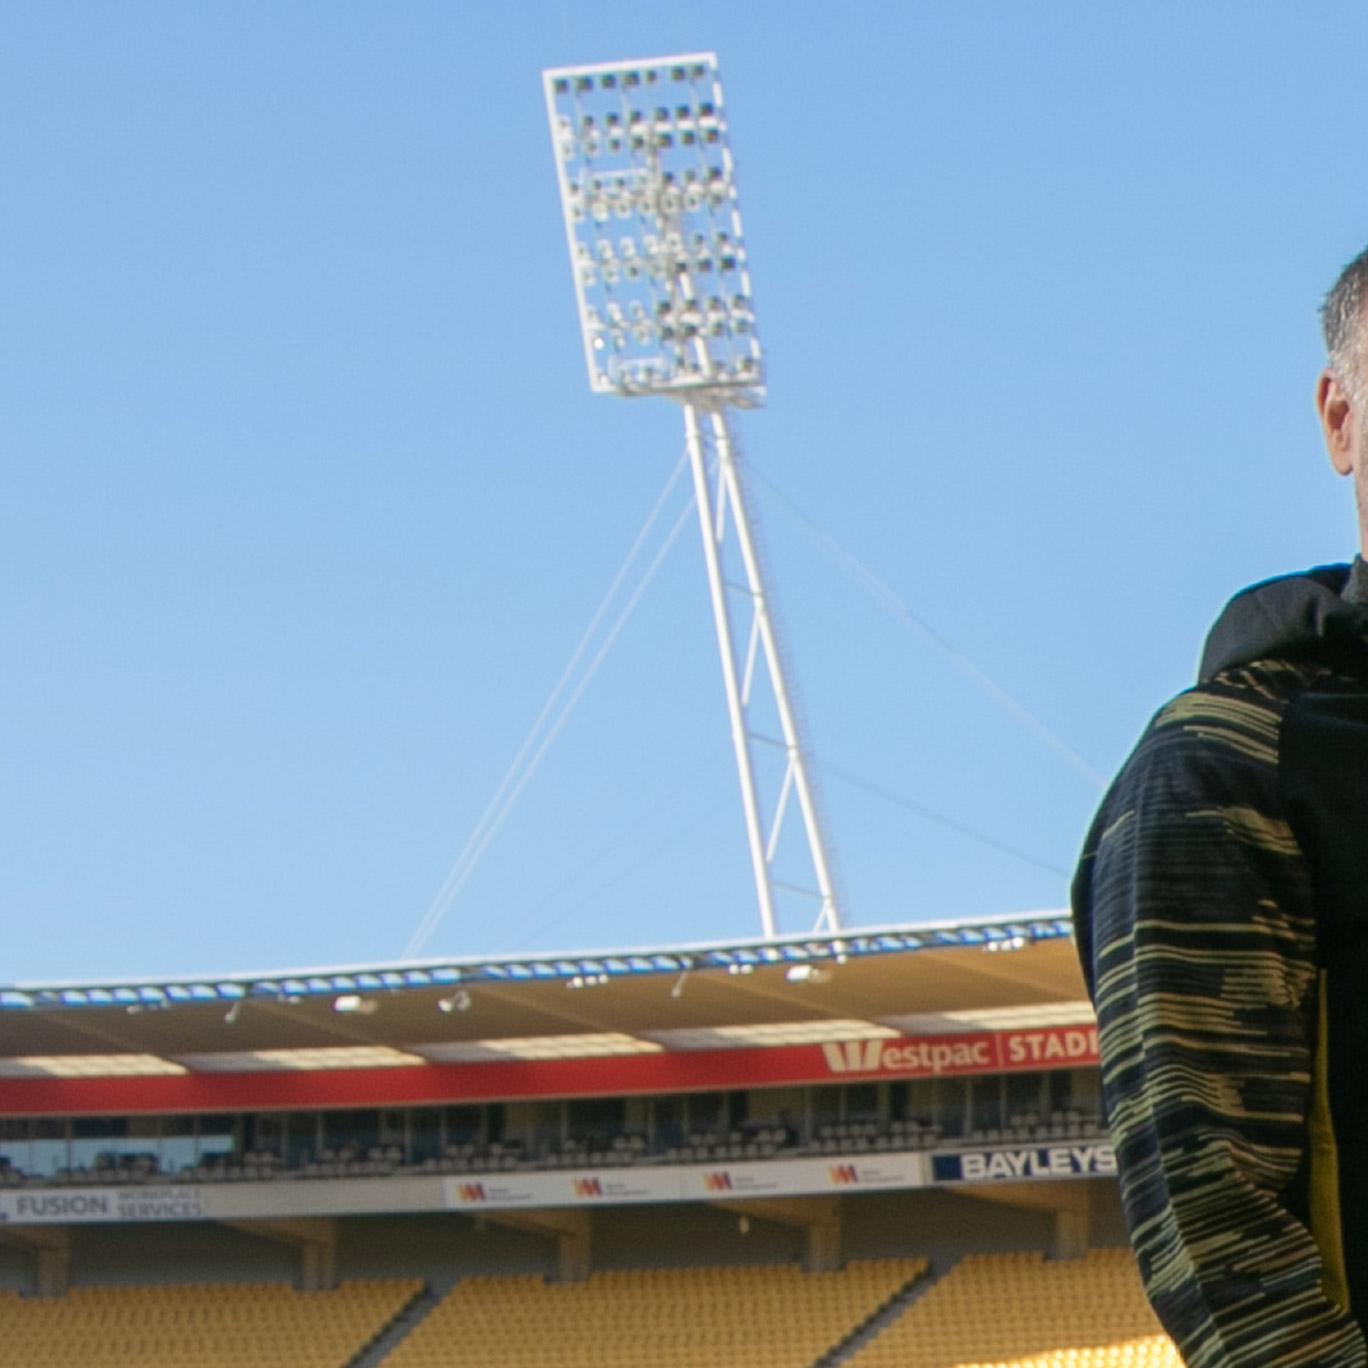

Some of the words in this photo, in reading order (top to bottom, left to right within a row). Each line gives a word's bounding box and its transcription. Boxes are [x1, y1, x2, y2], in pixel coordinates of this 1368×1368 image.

[821, 1039, 990, 1075] Westpac
[1008, 1027, 1100, 1062] STADI
[960, 1144, 1118, 1180] BAYLEYS
[16, 1195, 108, 1216] FUSION
